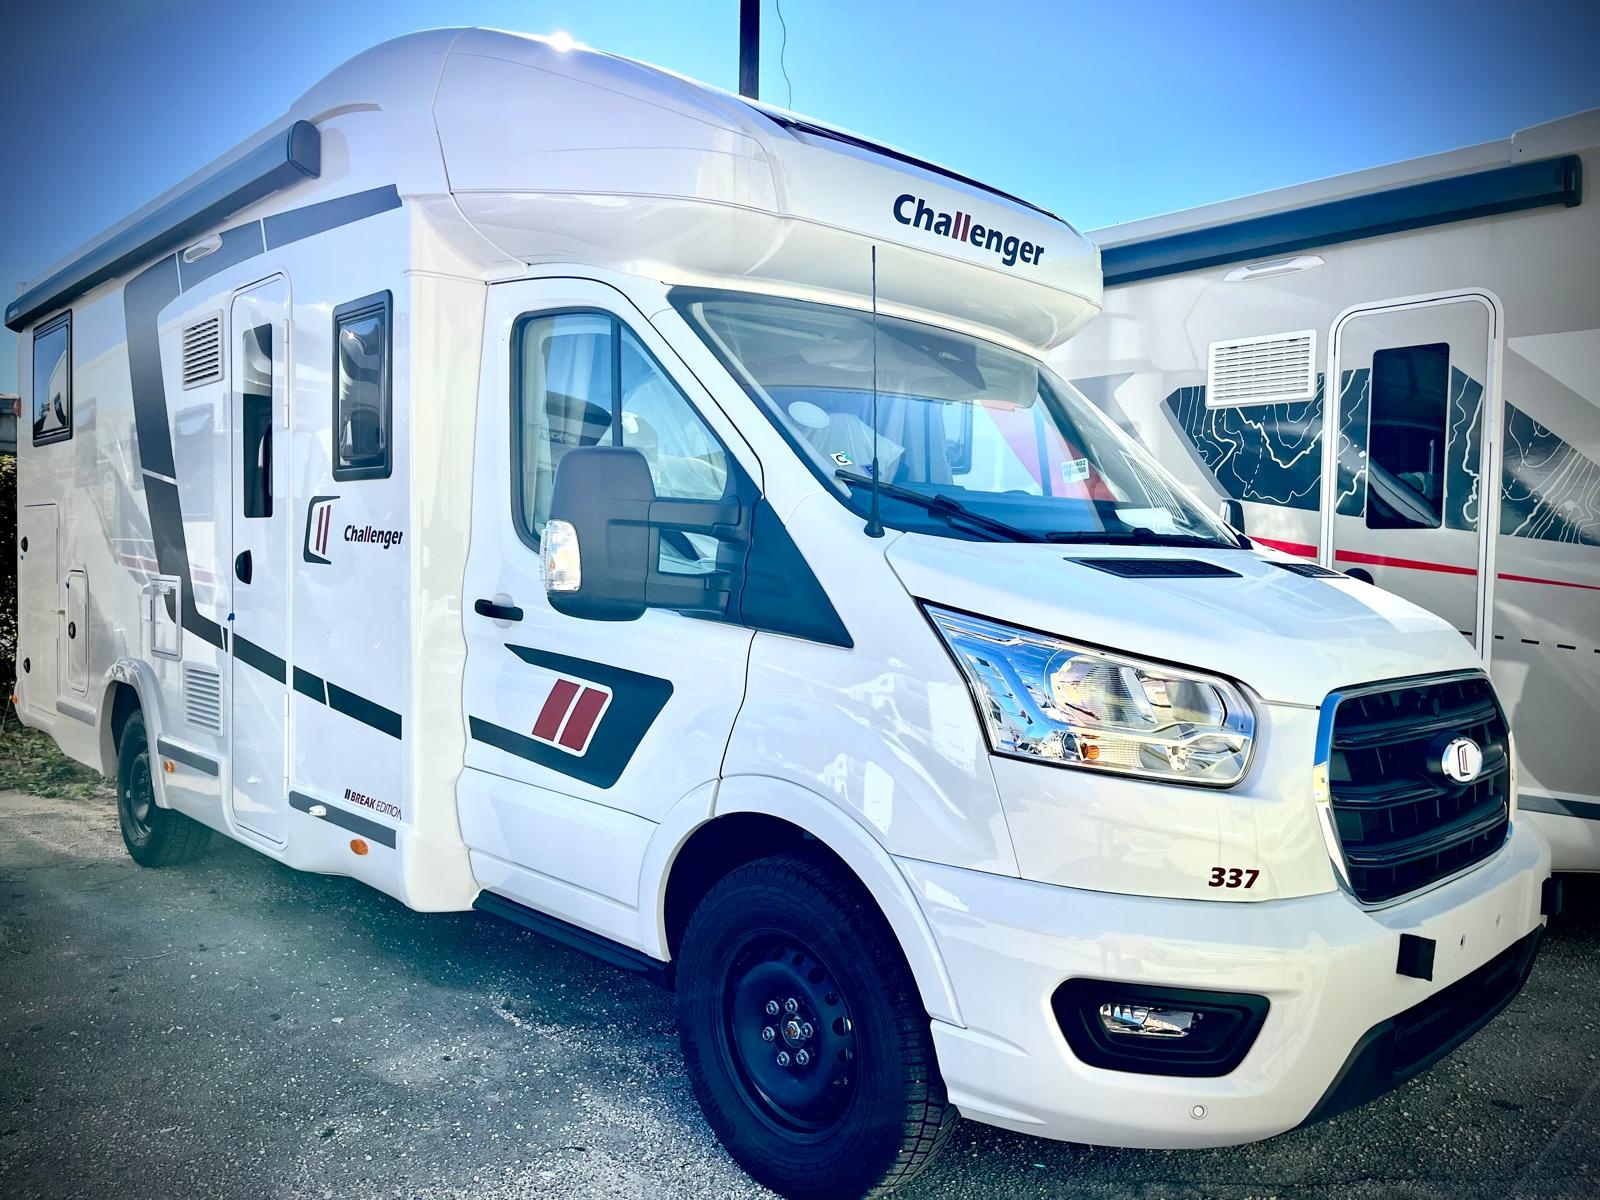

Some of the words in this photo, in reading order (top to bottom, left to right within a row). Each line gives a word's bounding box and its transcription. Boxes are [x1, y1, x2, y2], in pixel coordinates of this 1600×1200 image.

[892, 193, 1045, 267] Challenger
[343, 524, 404, 550] Challenger
[350, 791, 377, 810] BREAK
[1208, 866, 1260, 889] 337
